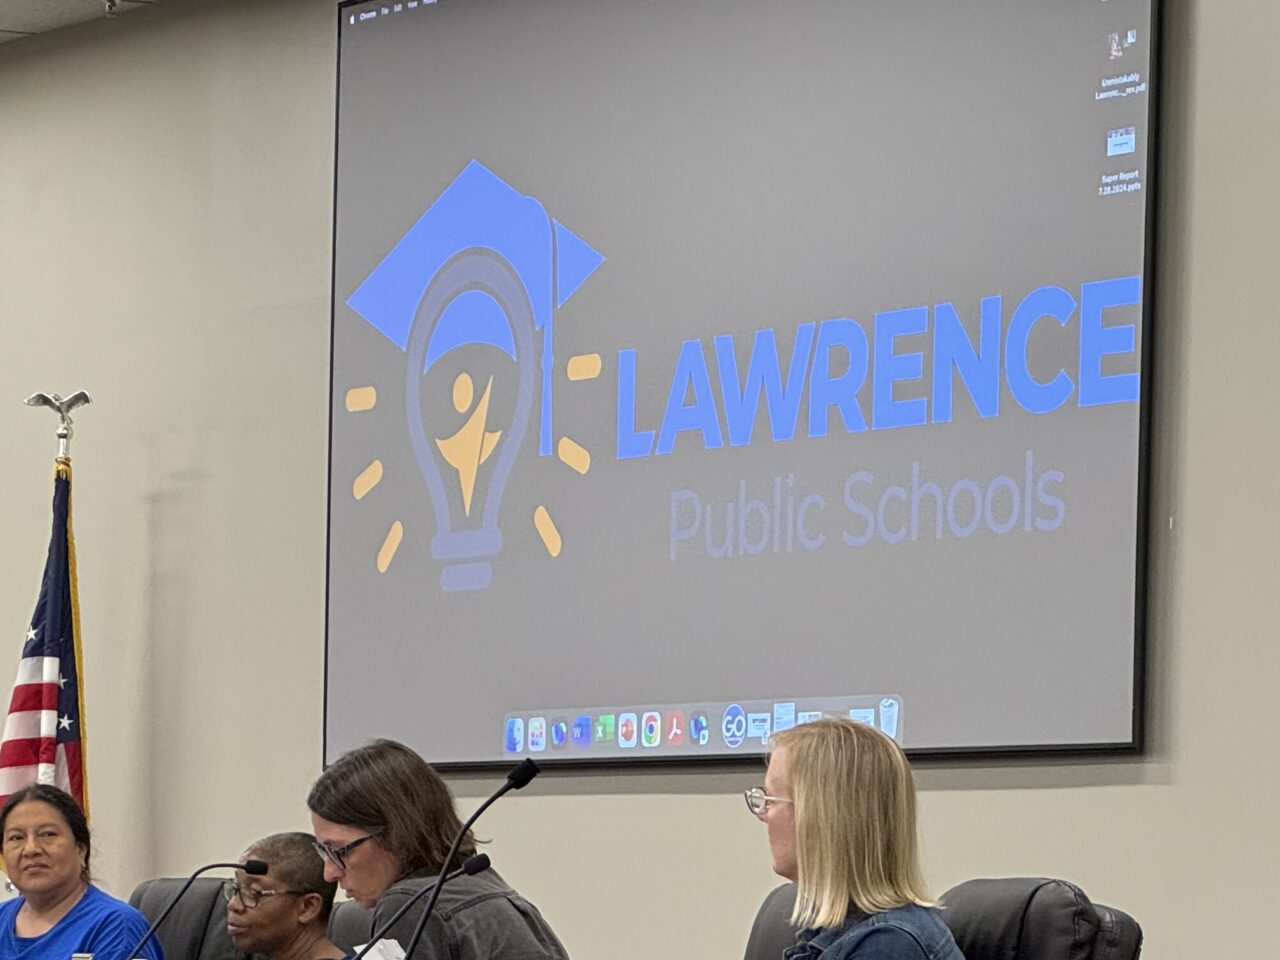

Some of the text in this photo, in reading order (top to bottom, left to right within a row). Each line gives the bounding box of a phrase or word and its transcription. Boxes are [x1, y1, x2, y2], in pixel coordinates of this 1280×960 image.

[616, 275, 1141, 459] LAWRENCE
[669, 450, 1066, 561] Public Schools
[722, 715, 747, 737] GO
